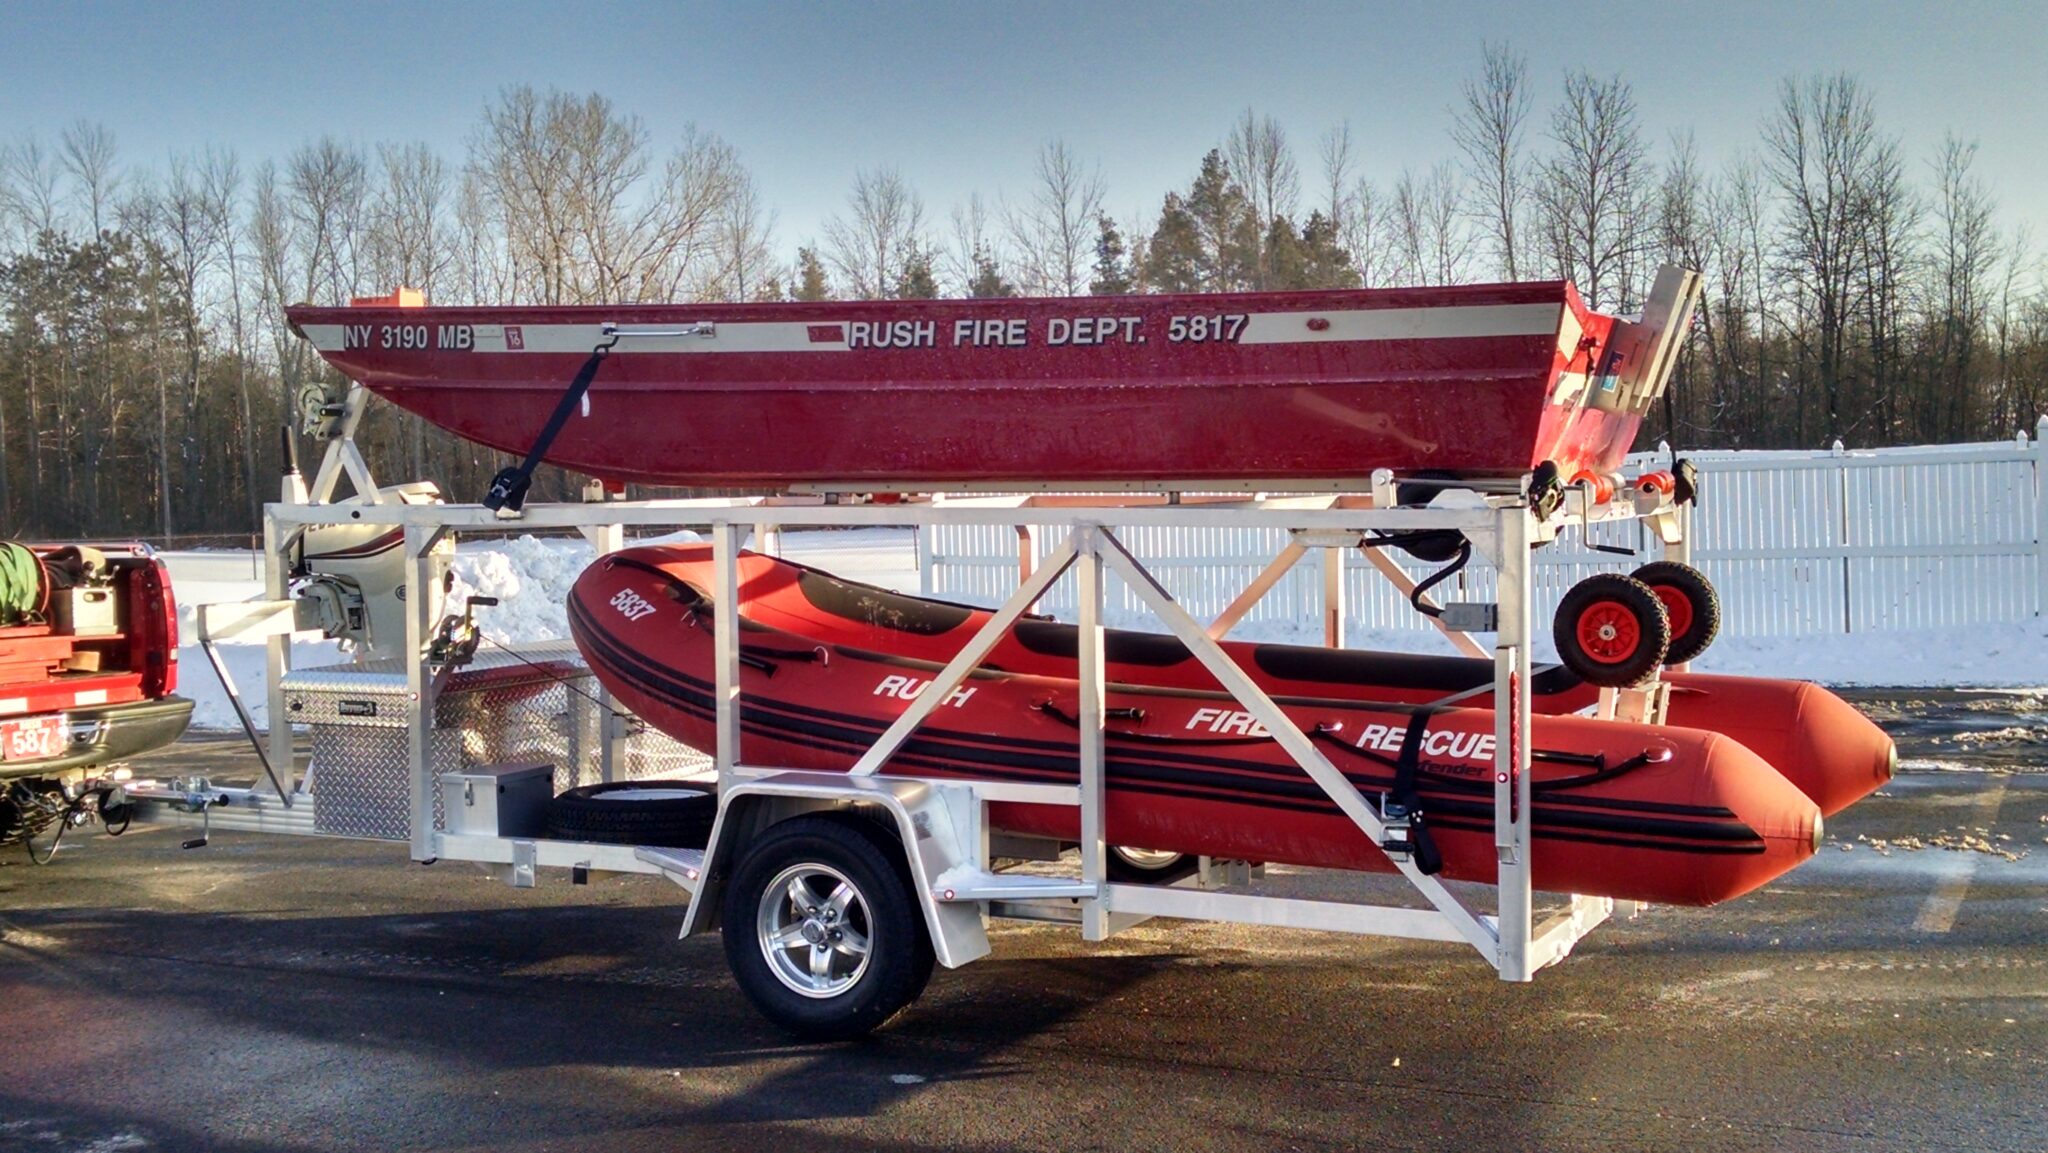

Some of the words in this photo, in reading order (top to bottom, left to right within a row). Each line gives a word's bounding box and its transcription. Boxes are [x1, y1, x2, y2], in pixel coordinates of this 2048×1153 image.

[344, 324, 373, 348] NY
[381, 324, 428, 349] 3190
[437, 324, 472, 349] MB
[850, 320, 936, 348] RUSH
[953, 319, 1028, 346] FIRE
[1047, 316, 1146, 345] DEPT.
[1168, 314, 1246, 341] 5817
[610, 588, 656, 621] 5837
[873, 675, 978, 708] RUH
[12, 727, 50, 754] 587
